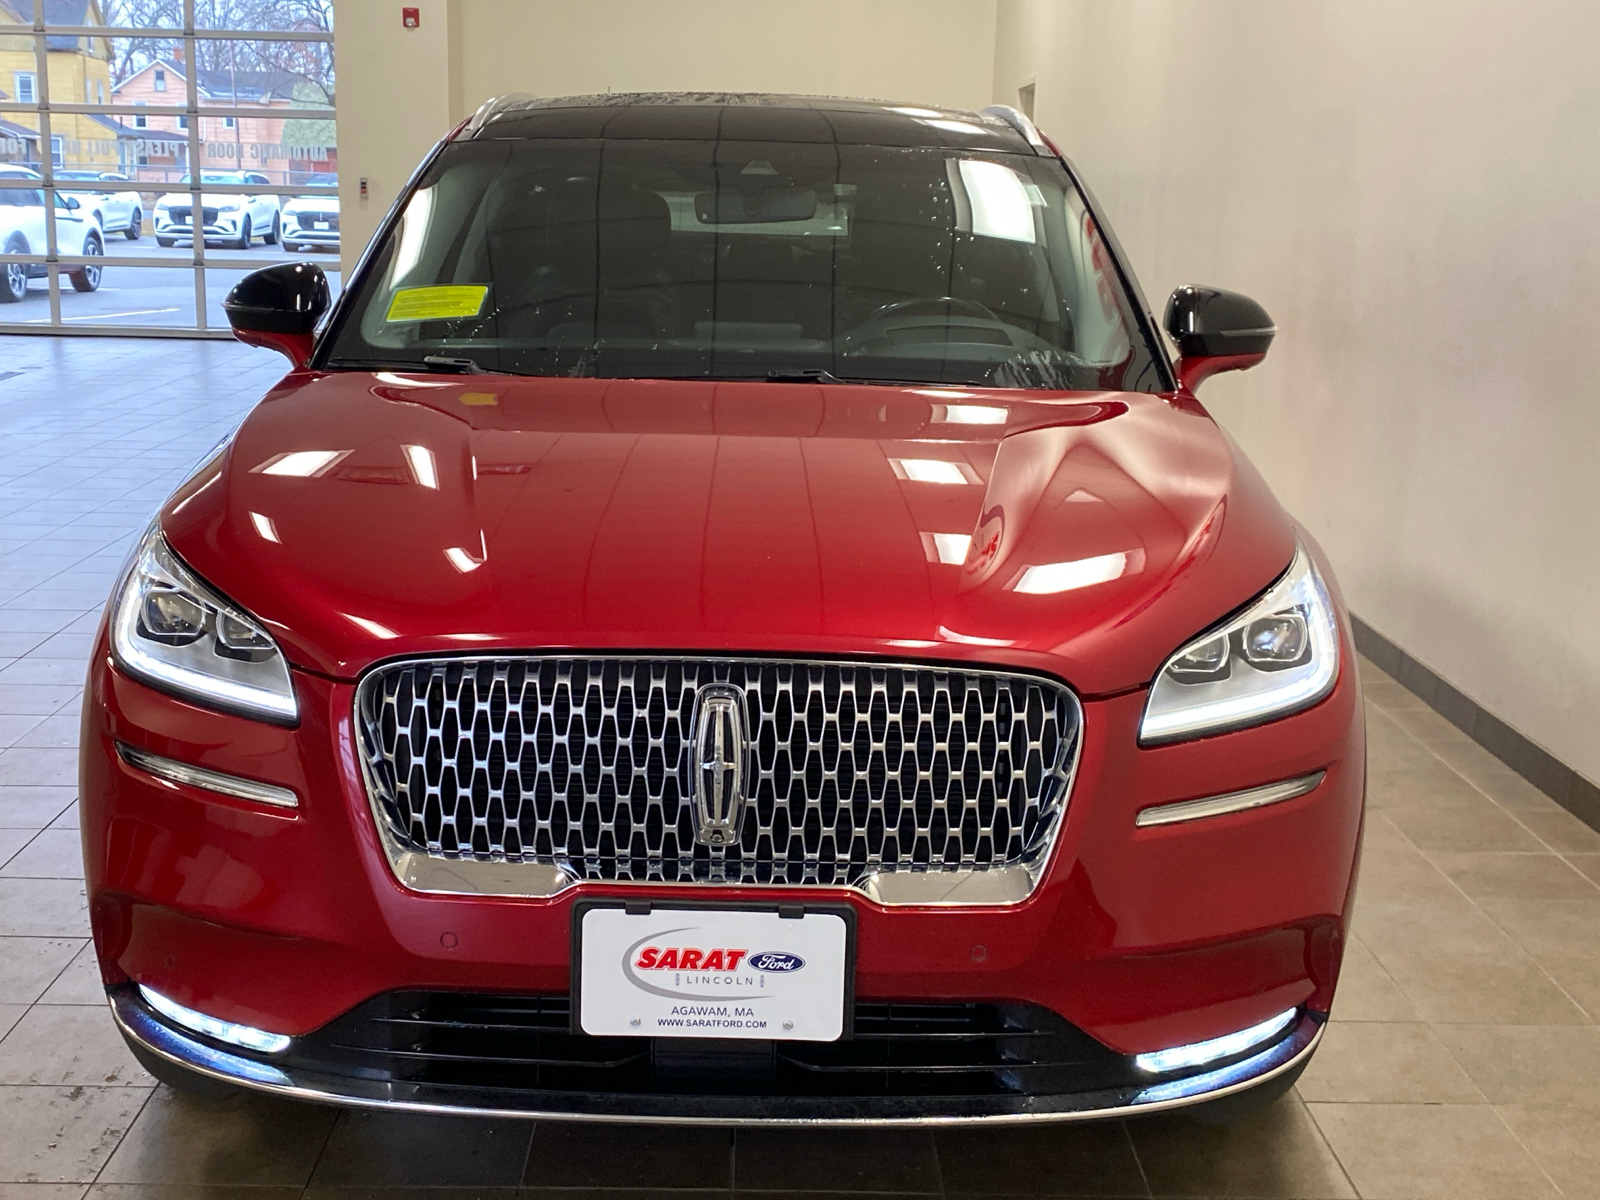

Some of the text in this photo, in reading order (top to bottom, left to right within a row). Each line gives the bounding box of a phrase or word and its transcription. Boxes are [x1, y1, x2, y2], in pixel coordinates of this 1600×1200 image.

[635, 946, 795, 972] SARAT Ford
[686, 975, 753, 986] LINCOLN
[671, 1006, 754, 1017] AGAWAM, MA
[657, 1018, 768, 1029] WWW.SARATFORD.COM
